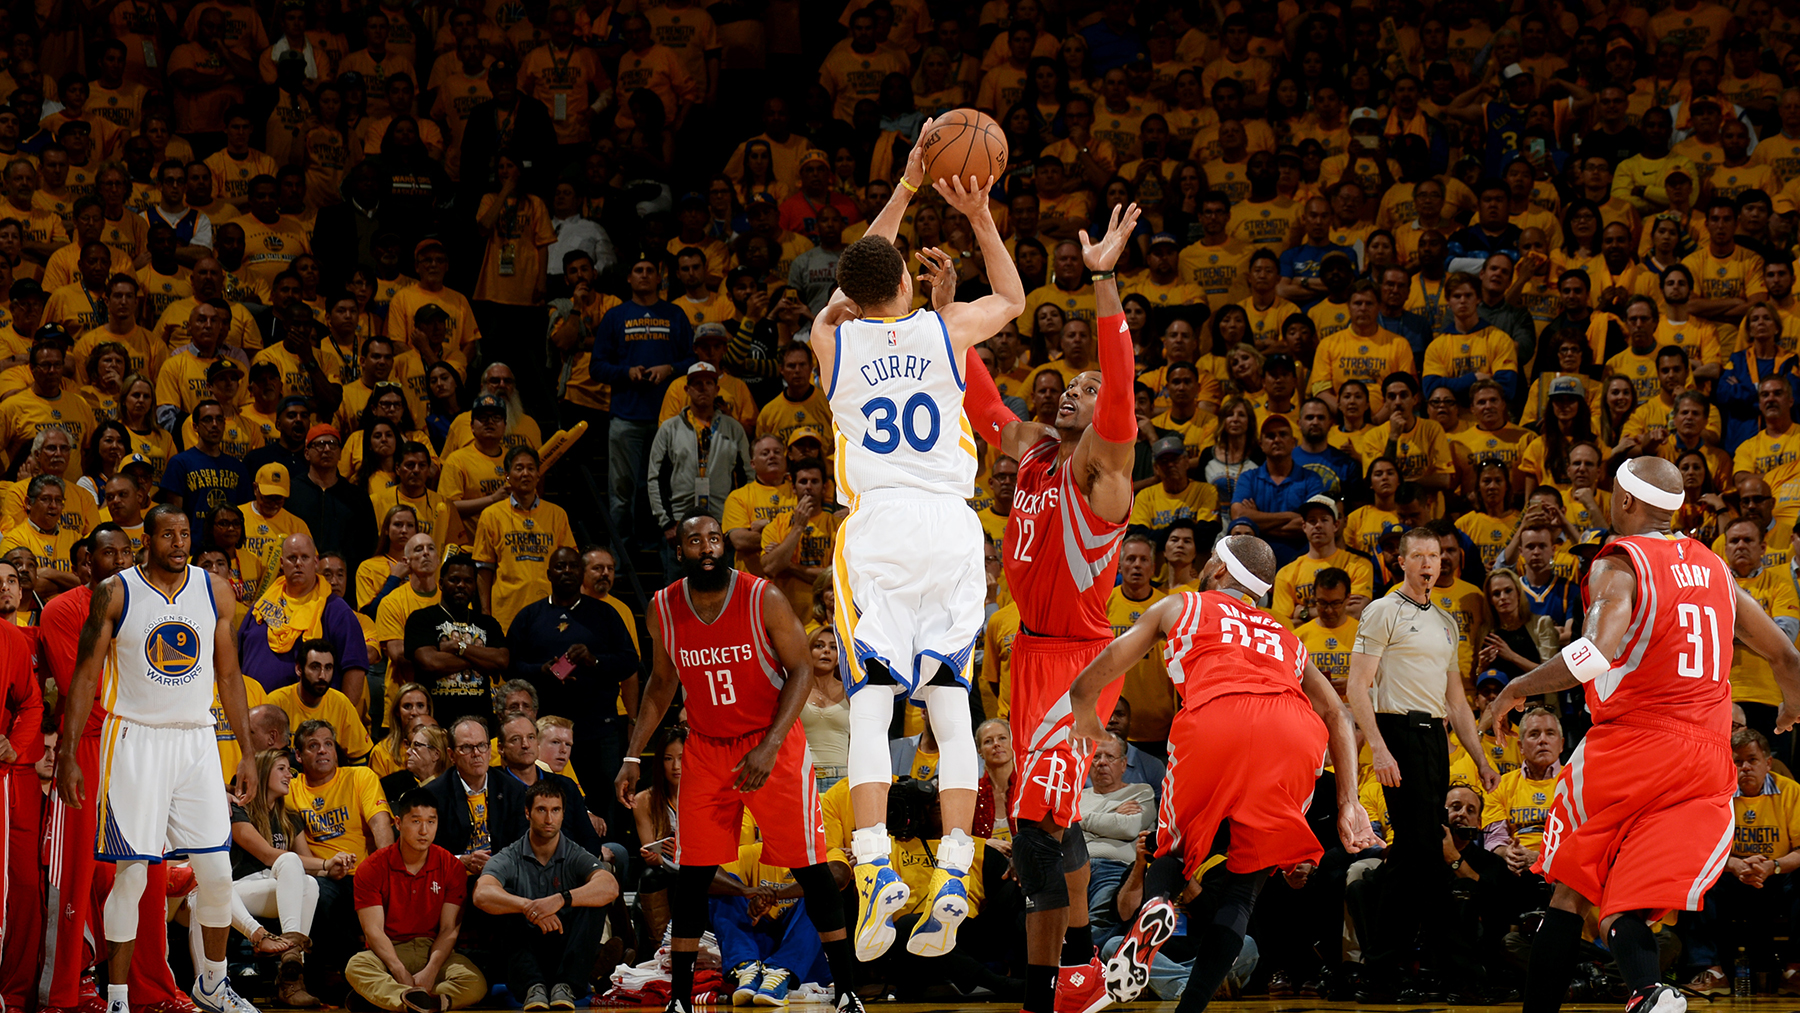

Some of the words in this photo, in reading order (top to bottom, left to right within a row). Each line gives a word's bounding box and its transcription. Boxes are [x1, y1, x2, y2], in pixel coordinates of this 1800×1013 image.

[1244, 219, 1290, 231] STRENGTH
[1193, 269, 1237, 282] STRENGTH
[624, 319, 671, 329] WARRIORS
[624, 333, 670, 342] BASKETBALL
[860, 355, 931, 386] CURRY
[1339, 358, 1386, 371] STRENGTH
[861, 392, 941, 454] 30
[504, 533, 553, 547] STRENGTH
[1016, 518, 1035, 562] 12
[520, 546, 548, 554] NUMBERS
[1670, 564, 1711, 590] TERRY
[144, 617, 172, 635] GOLDEN
[176, 615, 201, 632] STATE
[177, 631, 187, 647] 9
[1678, 603, 1720, 682] 31
[679, 643, 753, 668] ROCKETS
[1309, 652, 1350, 666] TRENGT
[1572, 645, 1591, 667] 31
[146, 664, 203, 686] WARRIORS
[705, 668, 737, 707] 13
[1734, 832, 1779, 849] RENGTH
